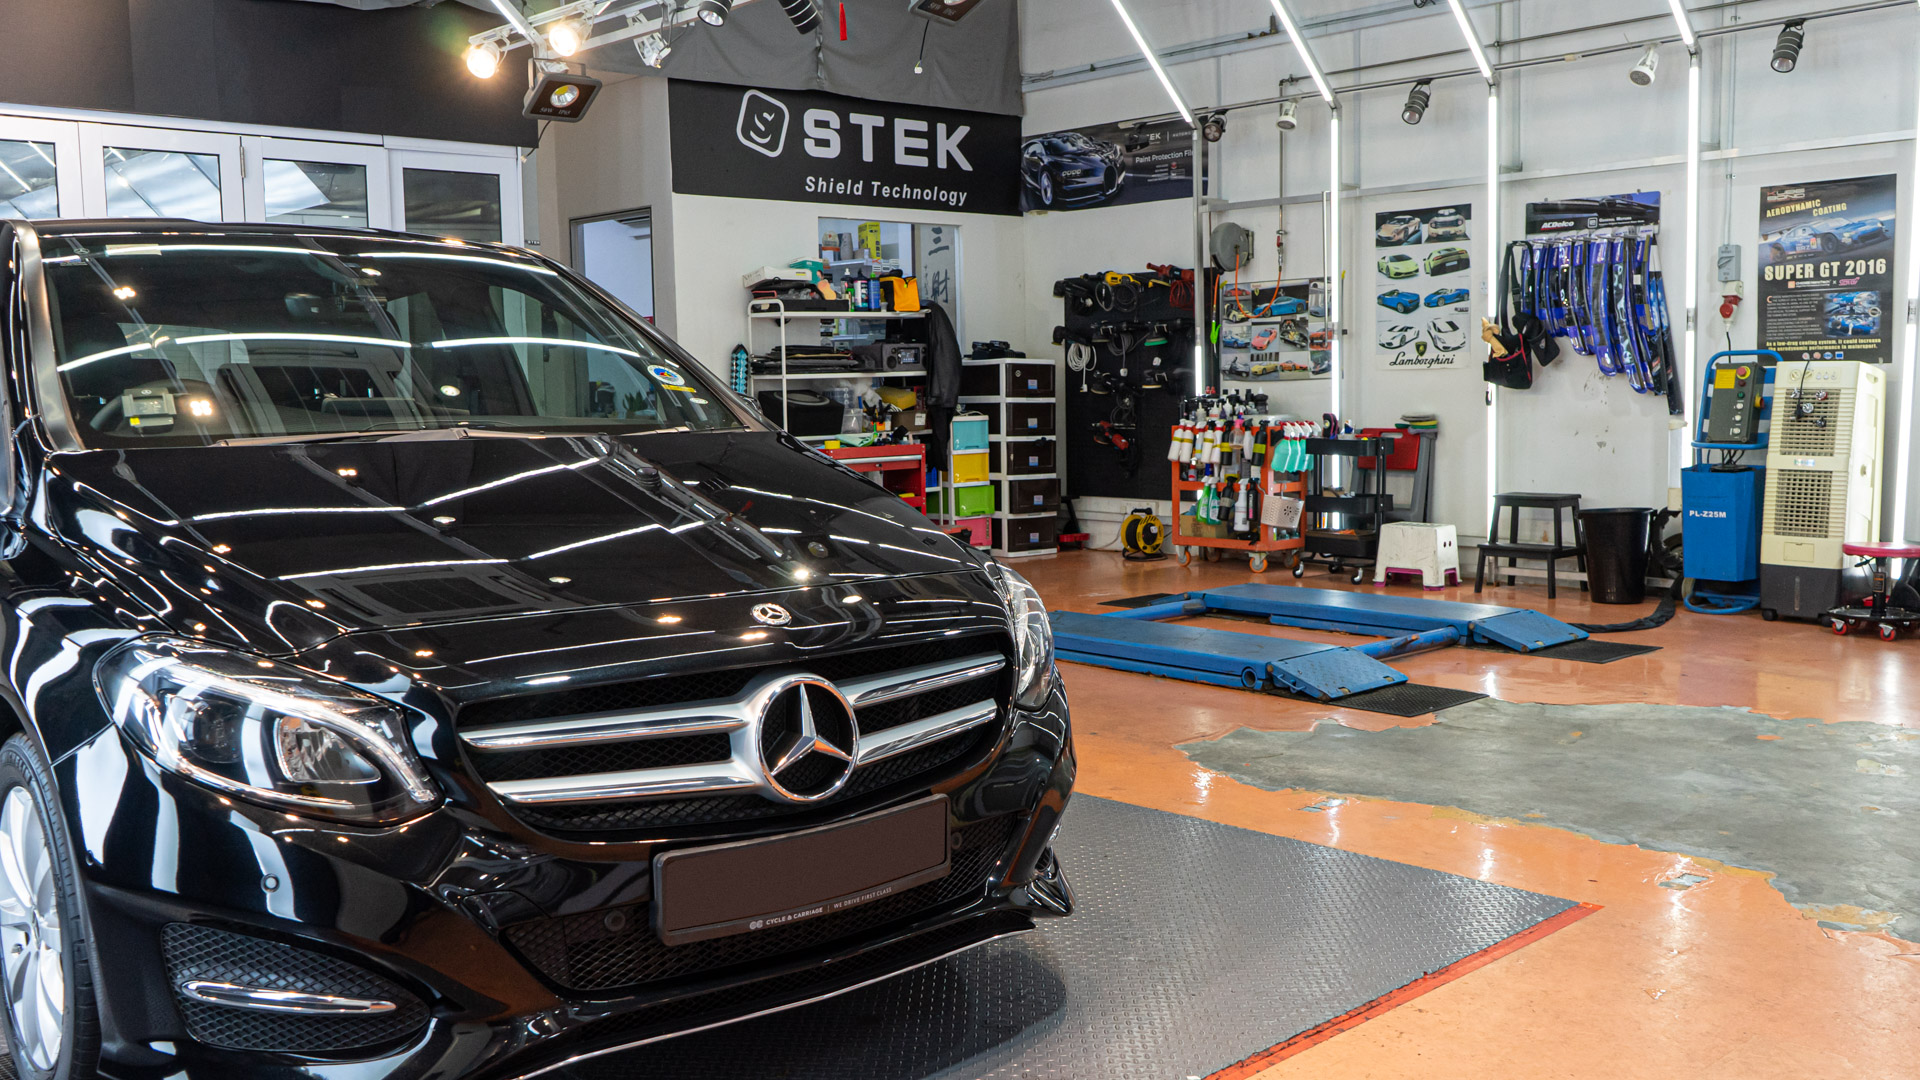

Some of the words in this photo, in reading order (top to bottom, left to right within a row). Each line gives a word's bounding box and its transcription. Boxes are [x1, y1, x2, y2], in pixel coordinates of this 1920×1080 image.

[803, 108, 974, 172] STEK
[1135, 156, 1151, 164] Paint
[1152, 151, 1184, 161] Protection
[1184, 149, 1194, 157] Fil
[805, 176, 863, 196] Shield
[871, 181, 967, 207] Technology
[1766, 199, 1821, 218] AERODYNAMIC
[1813, 202, 1848, 217] COATING
[1541, 220, 1575, 228] ACDelco
[1764, 263, 1815, 281] SUPER
[1820, 261, 1841, 278] GT
[1845, 258, 1887, 276] 2016
[1389, 351, 1455, 369] Lamborghini
[1689, 510, 1727, 519] PL-Z25M
[766, 914, 786, 926] CYCLE
[793, 907, 823, 919] CARRIAGE
[843, 897, 860, 906] DRIVE
[861, 892, 876, 901] FIRST
[876, 887, 892, 897] CLASS
